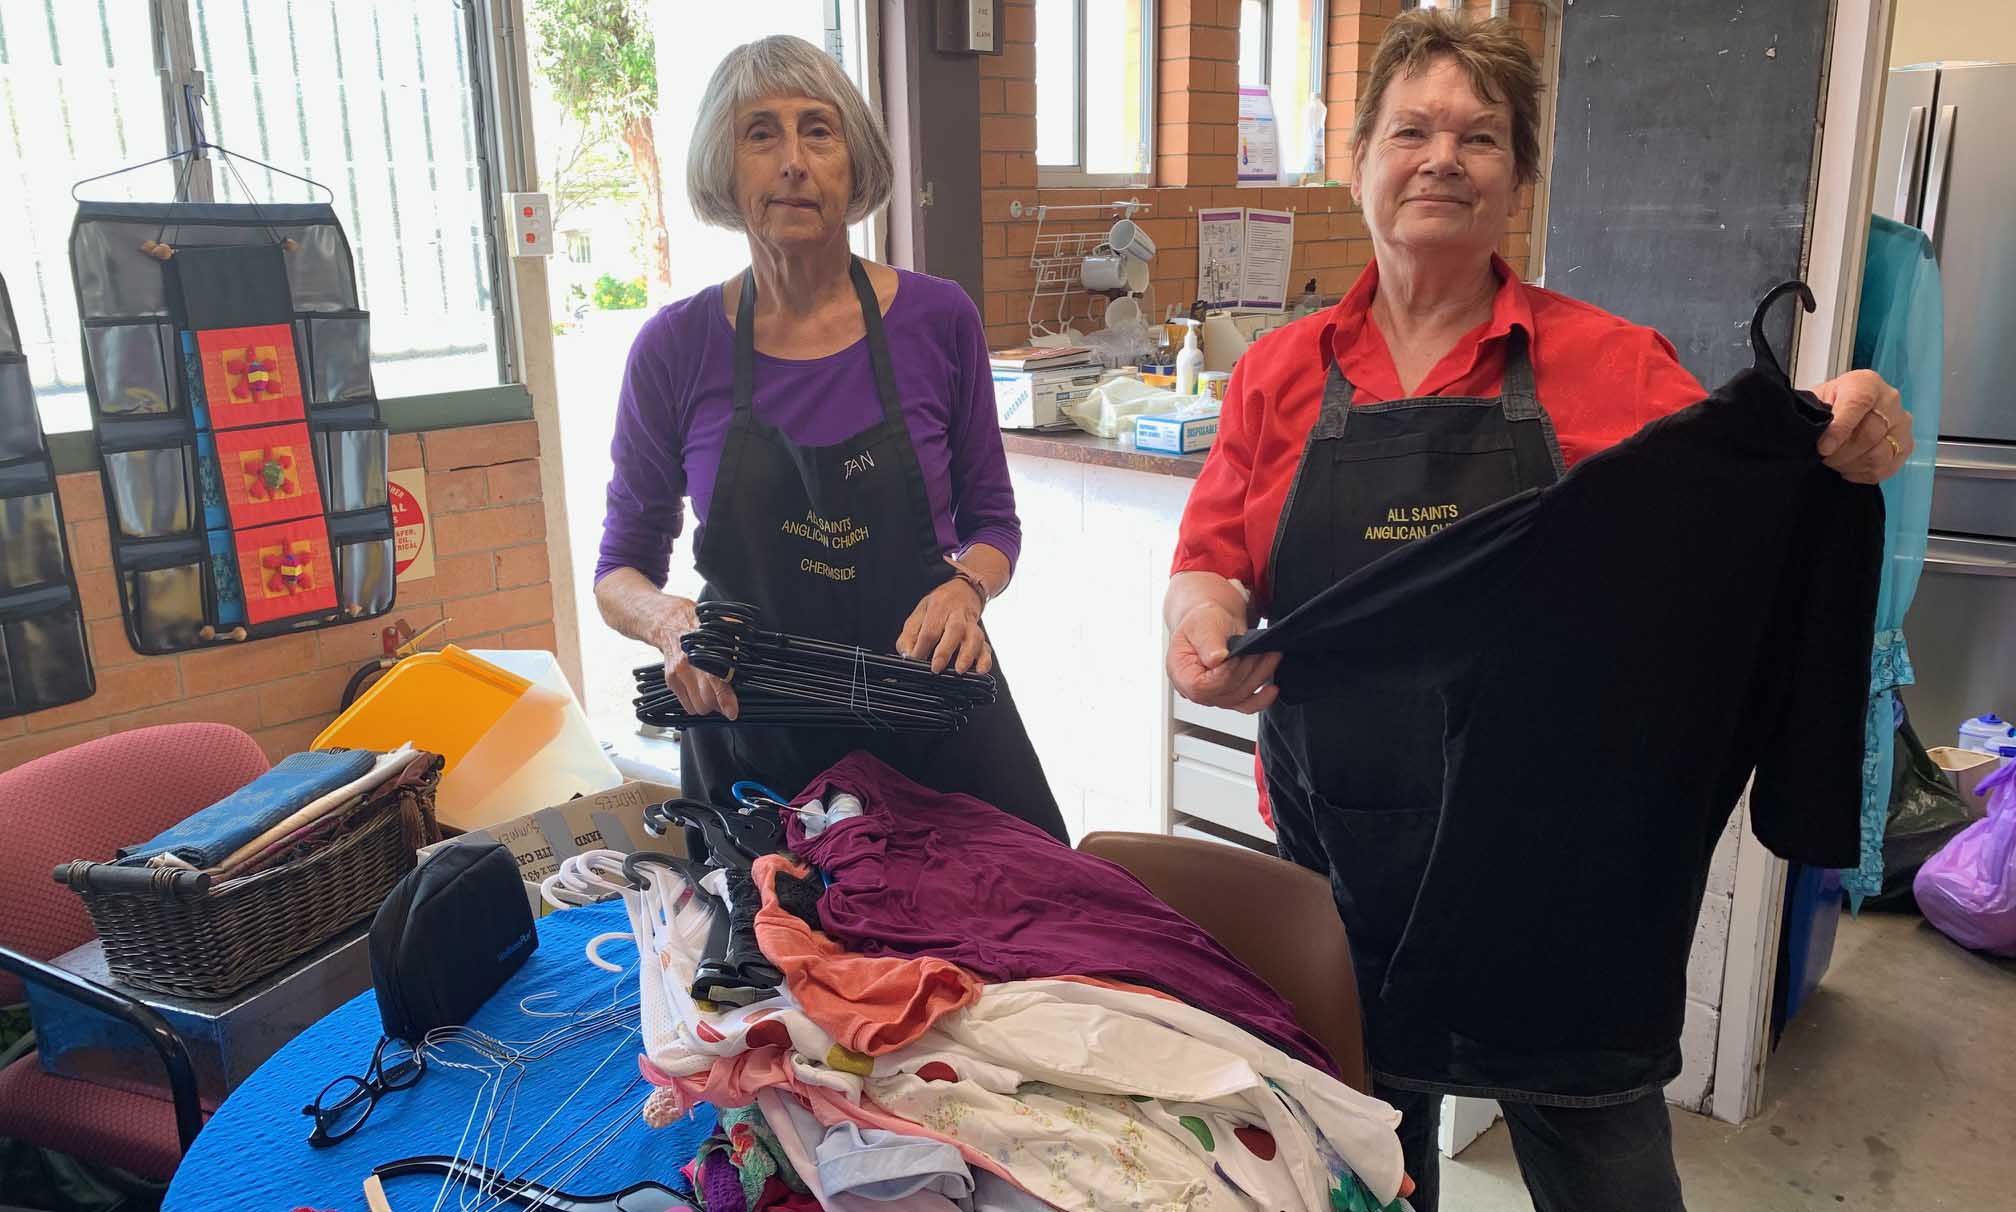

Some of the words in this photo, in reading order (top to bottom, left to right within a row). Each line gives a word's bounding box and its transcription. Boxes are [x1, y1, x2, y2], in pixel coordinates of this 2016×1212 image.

[843, 450, 875, 480] JAN
[1387, 508, 1409, 522] ALL
[1411, 504, 1458, 521] SAINTS
[781, 519, 829, 548] ANGLICAN
[832, 526, 869, 550] CHURCH
[817, 516, 851, 533] SAINTS
[1364, 524, 1426, 540] ANGLICAN
[800, 558, 856, 581] CHERMSIDE
